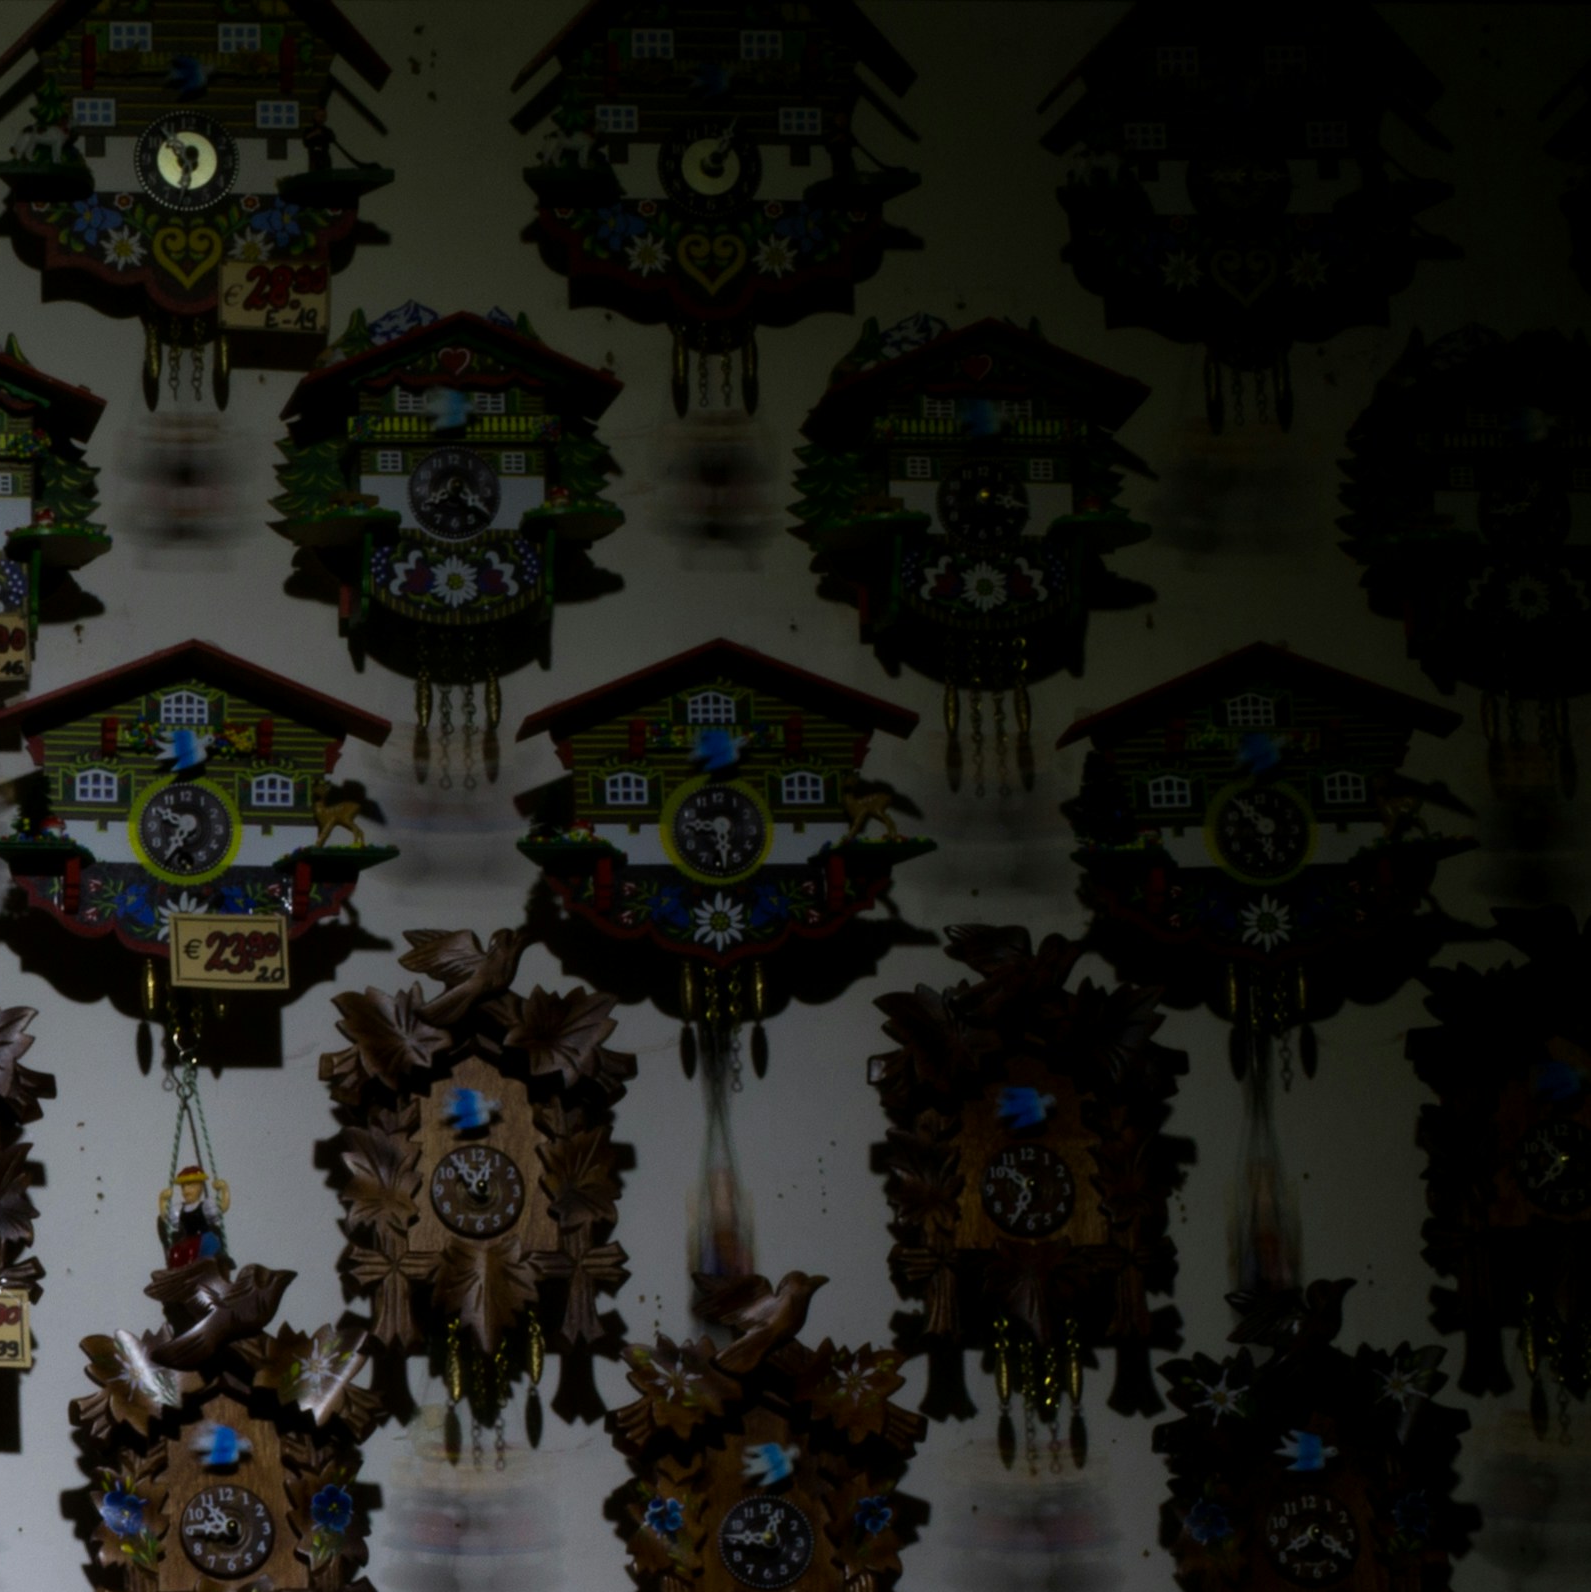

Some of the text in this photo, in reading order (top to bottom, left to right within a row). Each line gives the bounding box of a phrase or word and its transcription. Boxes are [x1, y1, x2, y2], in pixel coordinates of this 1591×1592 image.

[225, 284, 243, 306] €
[184, 939, 203, 959] €
[256, 967, 285, 982] 20
